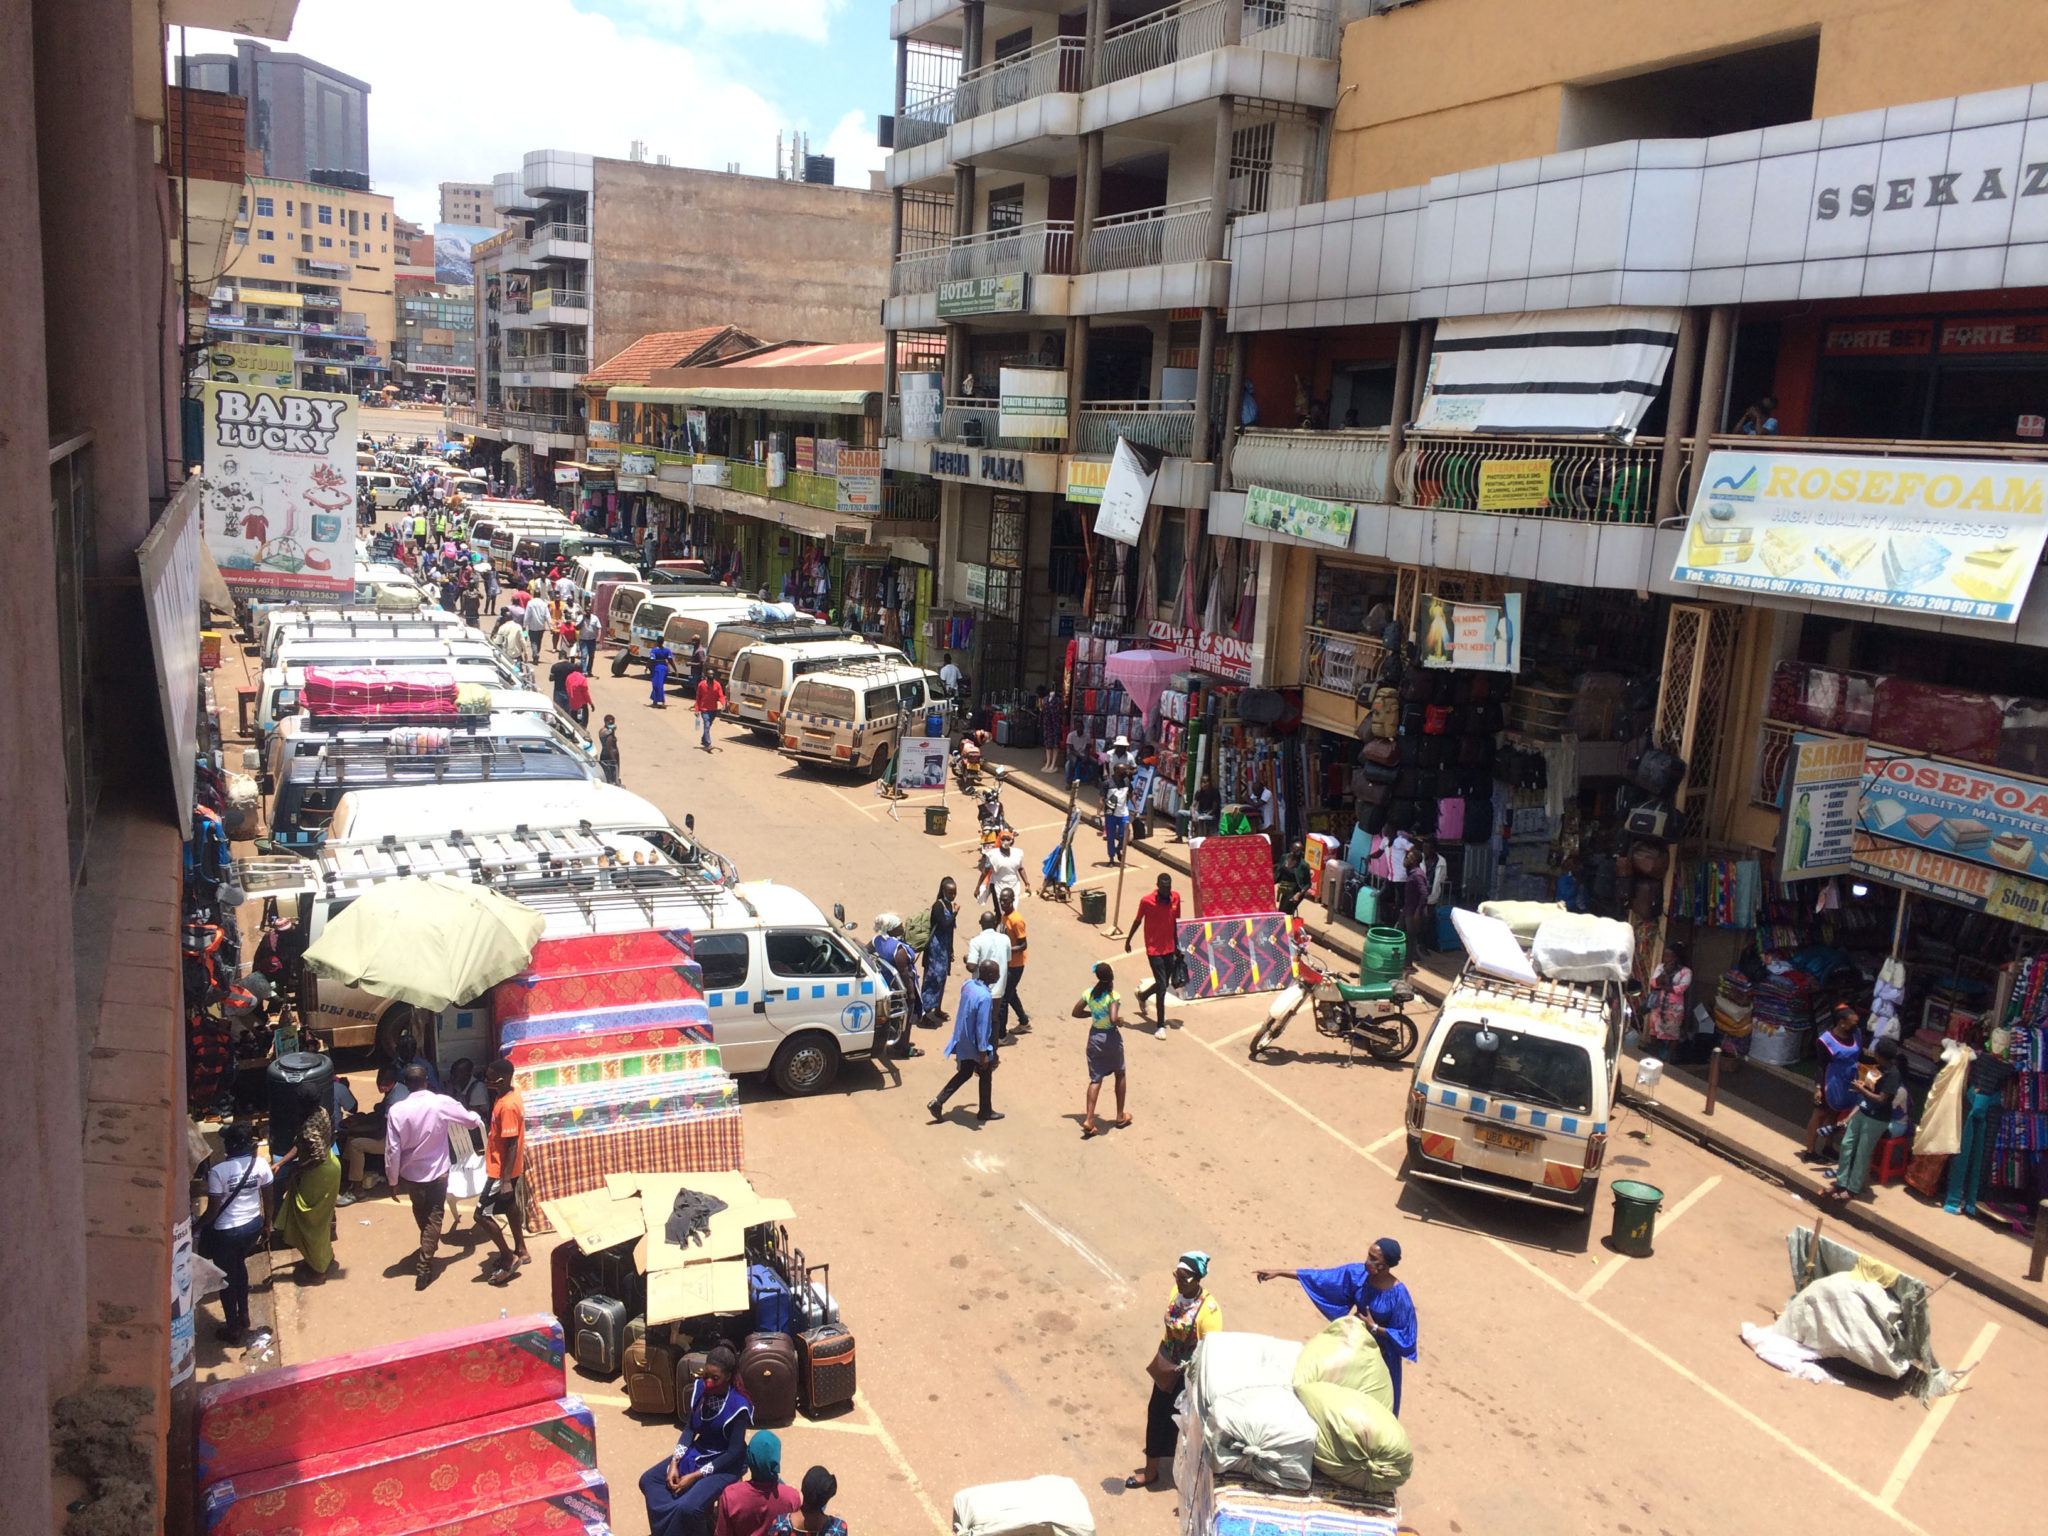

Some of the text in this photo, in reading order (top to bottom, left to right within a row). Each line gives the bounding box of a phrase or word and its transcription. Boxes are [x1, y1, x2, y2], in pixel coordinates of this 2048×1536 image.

[1816, 162, 2048, 221] SSEKAZ
[940, 278, 996, 300] HOTEL HP
[237, 357, 292, 372] STUDIO
[415, 365, 444, 373] STANDARD
[216, 390, 348, 432] BABY
[217, 423, 336, 454] LUCKY
[838, 451, 880, 467] SARAH
[981, 456, 1024, 485] PLAZA
[1269, 490, 1294, 507] BABY
[1295, 497, 1328, 515] WORLD
[1763, 466, 2046, 515] ROSEFOAM
[1771, 508, 2009, 539] HIGH QUALITY MATTRESSES
[290, 590, 309, 598] 0783
[1685, 569, 1706, 582] Tel:
[1709, 572, 1733, 586] +256
[1733, 575, 1750, 588] 756
[1821, 585, 1842, 599] 392
[1864, 590, 1887, 604] 545
[1896, 595, 1926, 610] +256
[1926, 597, 1951, 612] 200
[1462, 629, 1478, 637] AND
[1214, 635, 1253, 664] SONS
[1800, 742, 1865, 769] SARAH
[1897, 789, 1968, 813] QUALITY
[1852, 835, 1991, 894] OMESI CENTRE
[2001, 887, 2039, 913] Shop
